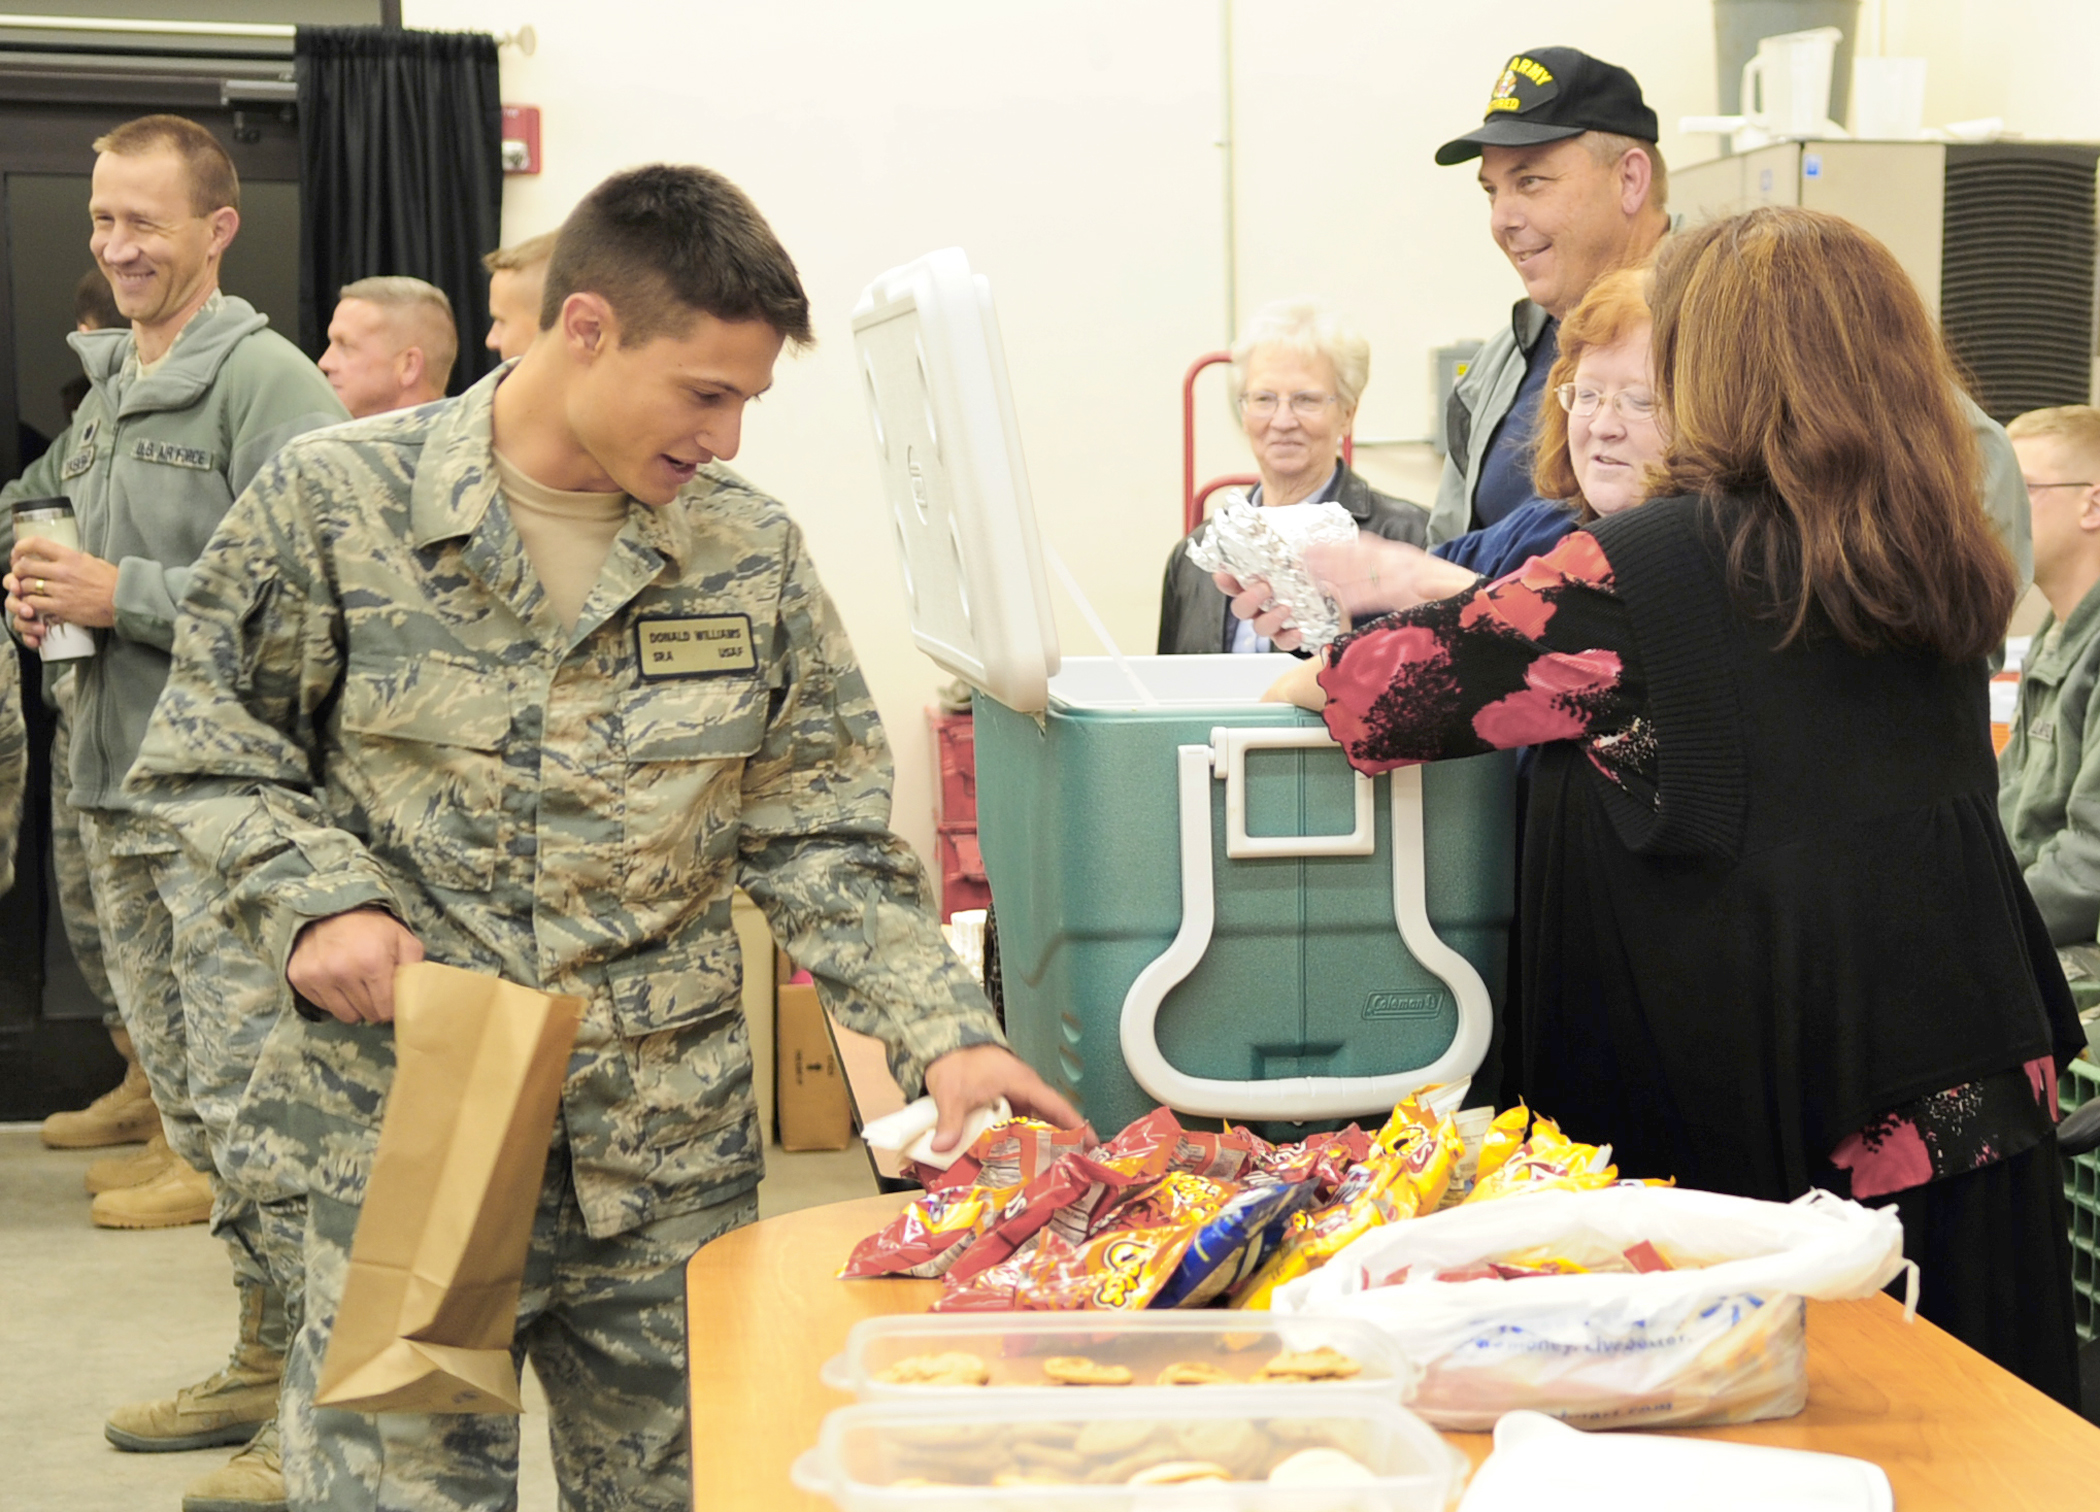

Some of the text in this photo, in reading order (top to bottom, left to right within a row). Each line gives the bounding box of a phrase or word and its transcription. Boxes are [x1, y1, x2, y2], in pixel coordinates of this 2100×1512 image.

[1508, 56, 1553, 86] ARMY
[159, 445, 174, 460] AIR
[176, 448, 206, 465] FORCE
[649, 628, 741, 643] DONALD WILLIAMS
[653, 646, 743, 662] SRA USAF
[1372, 995, 1425, 1010] Coleman
